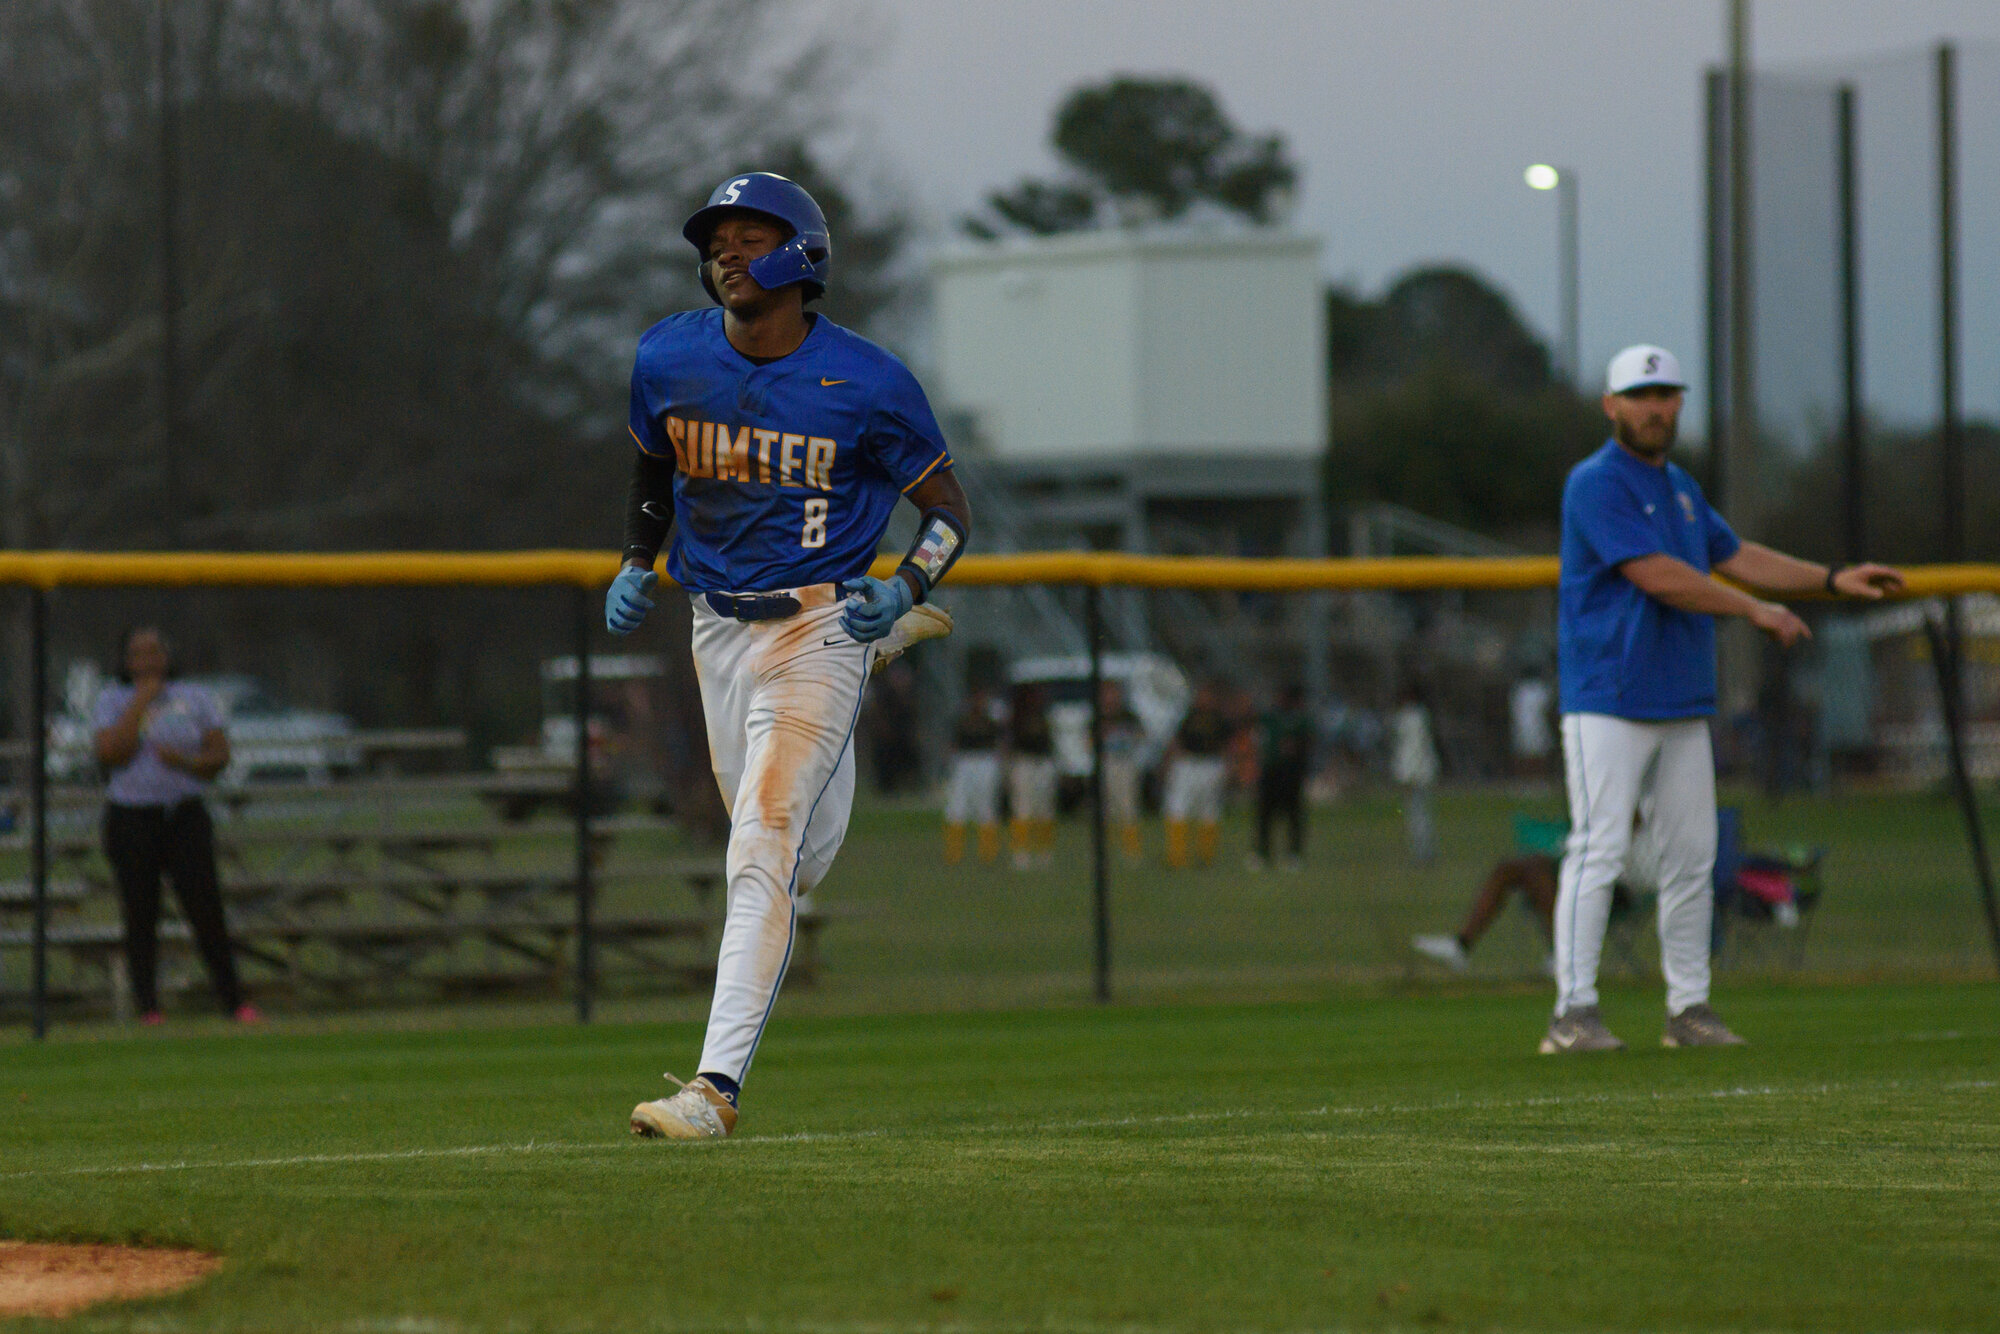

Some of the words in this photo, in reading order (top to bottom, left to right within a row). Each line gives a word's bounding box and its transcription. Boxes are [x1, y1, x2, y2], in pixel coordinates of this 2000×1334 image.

[719, 178, 750, 205] S
[1642, 353, 1661, 376] S
[666, 416, 837, 491] SUMTER
[801, 498, 828, 548] 8
